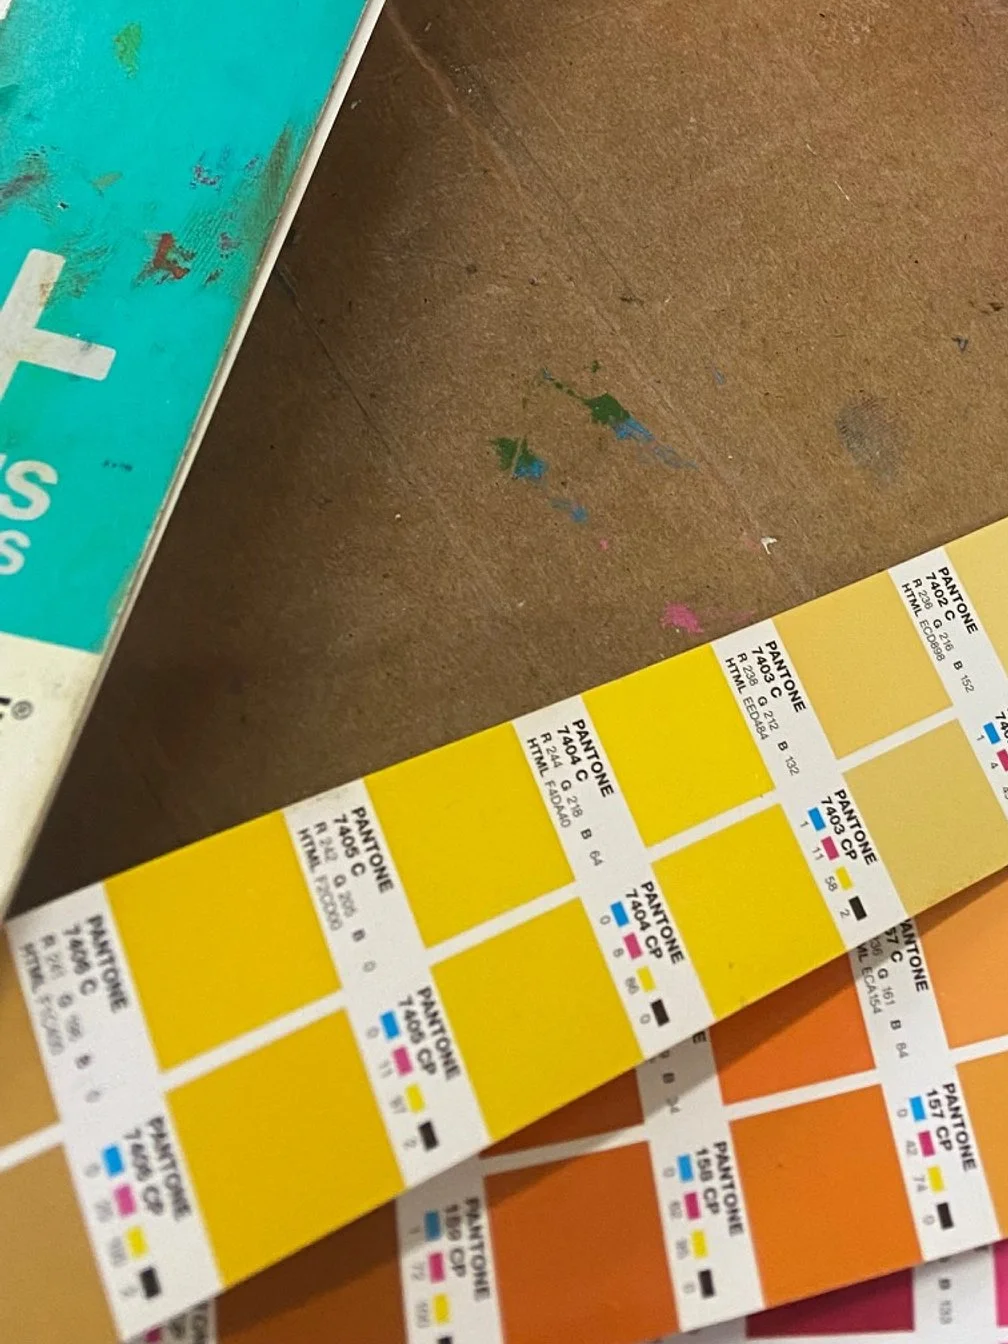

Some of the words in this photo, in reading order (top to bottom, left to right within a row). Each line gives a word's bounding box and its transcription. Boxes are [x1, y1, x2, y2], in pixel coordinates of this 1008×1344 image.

[911, 577, 924, 589] R
[916, 588, 934, 611] 236
[924, 570, 950, 609] 7402
[943, 608, 956, 622] C
[936, 565, 979, 635] PANTONE
[900, 581, 923, 618] HTML
[917, 617, 947, 663] ECD898
[931, 617, 943, 630] G
[736, 651, 749, 664] R
[937, 630, 955, 653] 216
[741, 664, 760, 687] 238
[750, 644, 776, 684] 7403
[769, 685, 783, 699] C
[764, 639, 807, 714] PANTONE
[952, 659, 964, 671] B
[724, 656, 747, 695] HTML
[741, 695, 770, 741] EED484
[959, 673, 975, 694] 152
[756, 694, 769, 708] G
[539, 731, 553, 744] R
[762, 709, 780, 732] 212
[544, 744, 564, 769] 244
[555, 723, 583, 766] 7404
[574, 768, 589, 783] C
[570, 717, 615, 799] PANTONE
[776, 739, 789, 752] B
[525, 736, 550, 779] HTML
[543, 778, 572, 829] F4DA40
[784, 754, 801, 777] 132
[559, 778, 573, 792] G
[565, 794, 584, 819] 218
[579, 827, 593, 841] B
[819, 794, 846, 836] 7403
[839, 837, 859, 861] CP
[833, 787, 878, 866] PANTONE
[296, 826, 322, 873] HTML
[332, 812, 361, 860] 7405
[349, 861, 367, 878] C
[350, 805, 394, 894] PANTONE
[588, 849, 604, 867] 64
[624, 887, 652, 932] 7404
[643, 934, 664, 960] CP
[639, 879, 685, 965] PANTONE
[85, 913, 129, 1012] PANTONE
[78, 977, 99, 996] C
[397, 994, 427, 1045] 7405
[415, 1046, 438, 1076] CP
[416, 985, 461, 1081] PANTONE
[925, 1088, 946, 1120] 157
[934, 1124, 954, 1152] CP
[941, 1081, 977, 1172] PANTONE
[146, 1115, 192, 1221] PANTONE
[694, 1146, 714, 1183] 158
[141, 1184, 165, 1216] CP
[701, 1186, 721, 1216] CP
[712, 1139, 744, 1236] PANTONE
